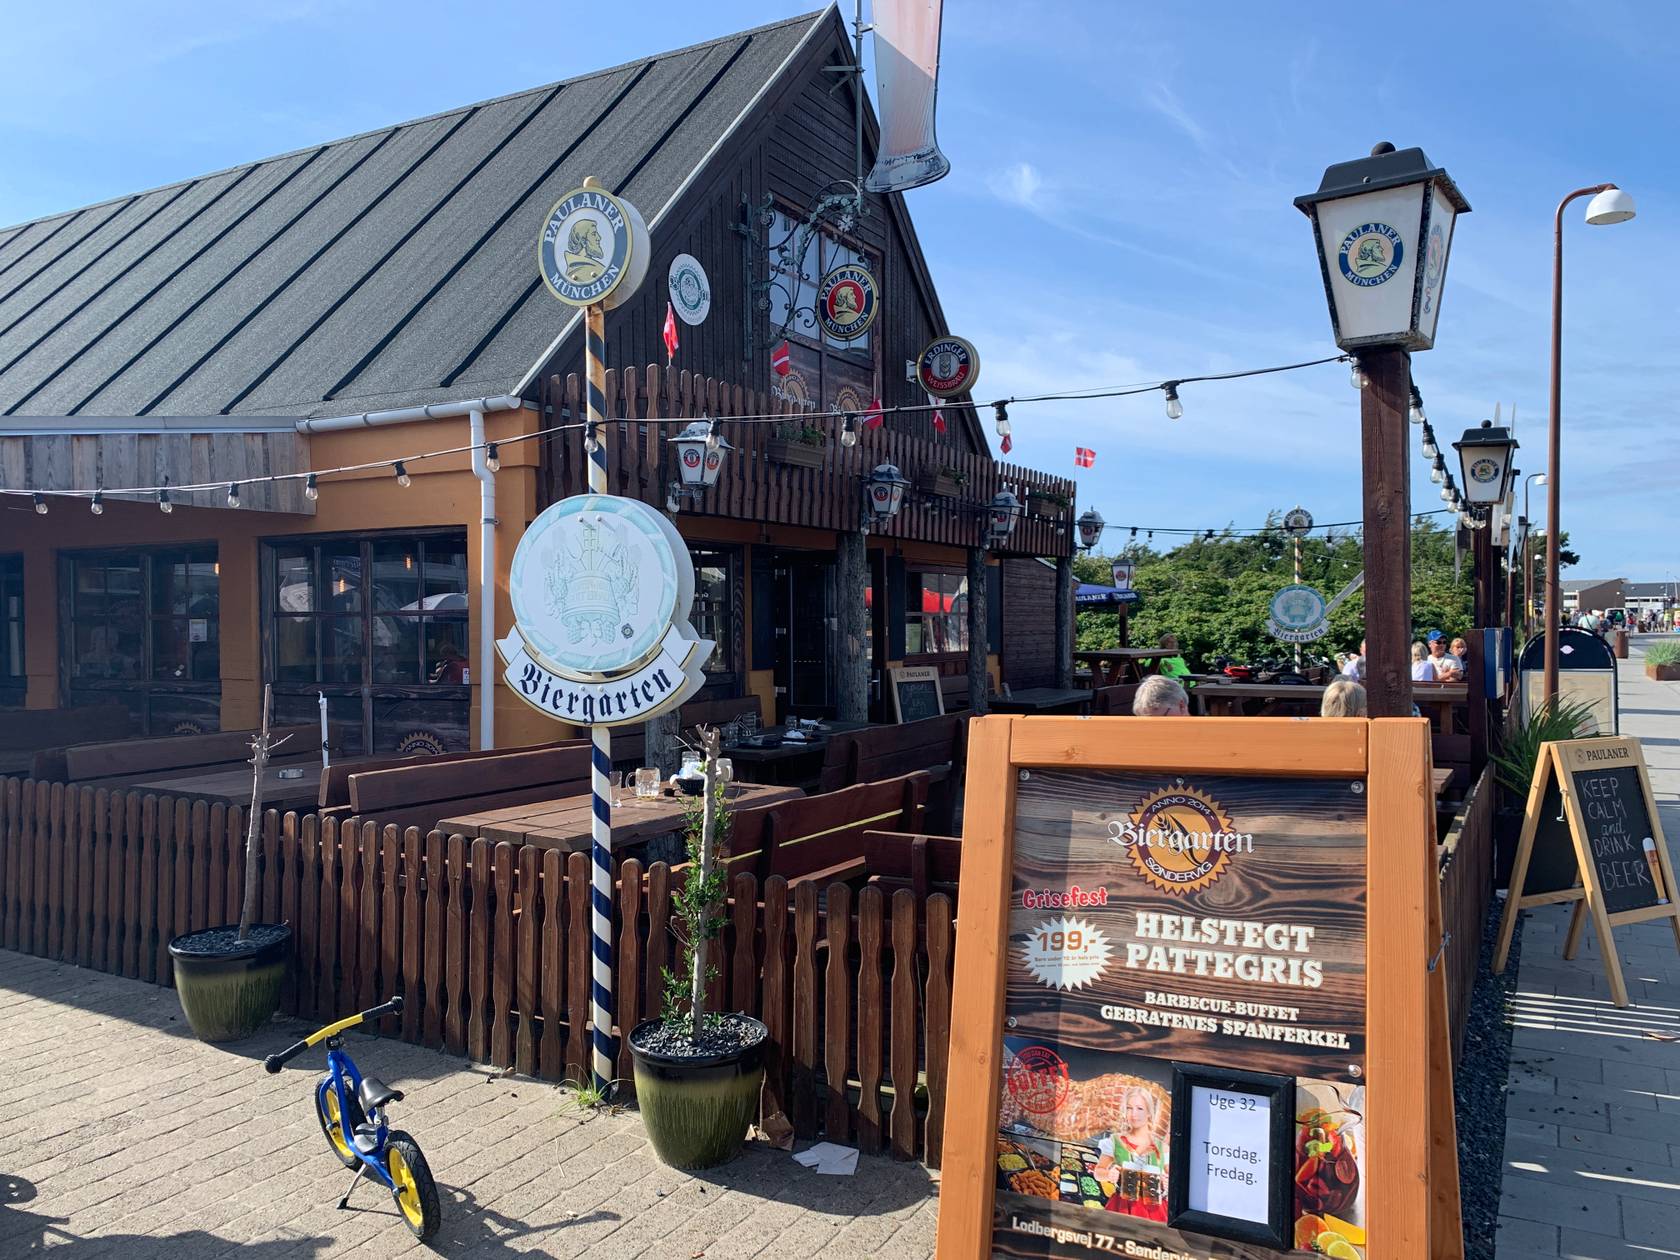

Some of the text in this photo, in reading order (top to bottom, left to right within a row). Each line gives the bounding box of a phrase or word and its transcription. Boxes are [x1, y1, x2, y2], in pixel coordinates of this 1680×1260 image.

[544, 193, 624, 243] PAULANER
[1340, 224, 1400, 254] PAULANER
[821, 271, 872, 300] PAULANER
[924, 344, 967, 365] ERDINGER
[1273, 627, 1324, 641] Biergarten
[519, 663, 672, 726] Biergarten
[1586, 748, 1630, 761] PAULANER
[1581, 777, 1619, 799] KEEP
[1152, 797, 1212, 815] ANNO 2014
[1588, 798, 1627, 820] CALM
[1107, 820, 1255, 855] Biergarten
[1601, 817, 1627, 837] and
[1594, 835, 1636, 858] DRINK
[1145, 857, 1213, 882] SØNDERVIG
[1600, 861, 1650, 891] BEER
[1022, 885, 1108, 909] Grisefest
[1036, 930, 1096, 952] 199,-
[1135, 912, 1315, 953] HELSTEGT
[1126, 944, 1323, 989] PATTEGRIS
[1144, 991, 1300, 1022] BARBECUE-BUFFET
[1100, 1005, 1350, 1050] GEBRATENES SPANFERKEL
[1209, 1093, 1256, 1111] Uge 32
[1202, 1141, 1261, 1164] Torsdag.
[1207, 1163, 1257, 1185] Fredag.
[1012, 1216, 1092, 1248] Lodbergsvej
[1094, 1237, 1115, 1250] 77
